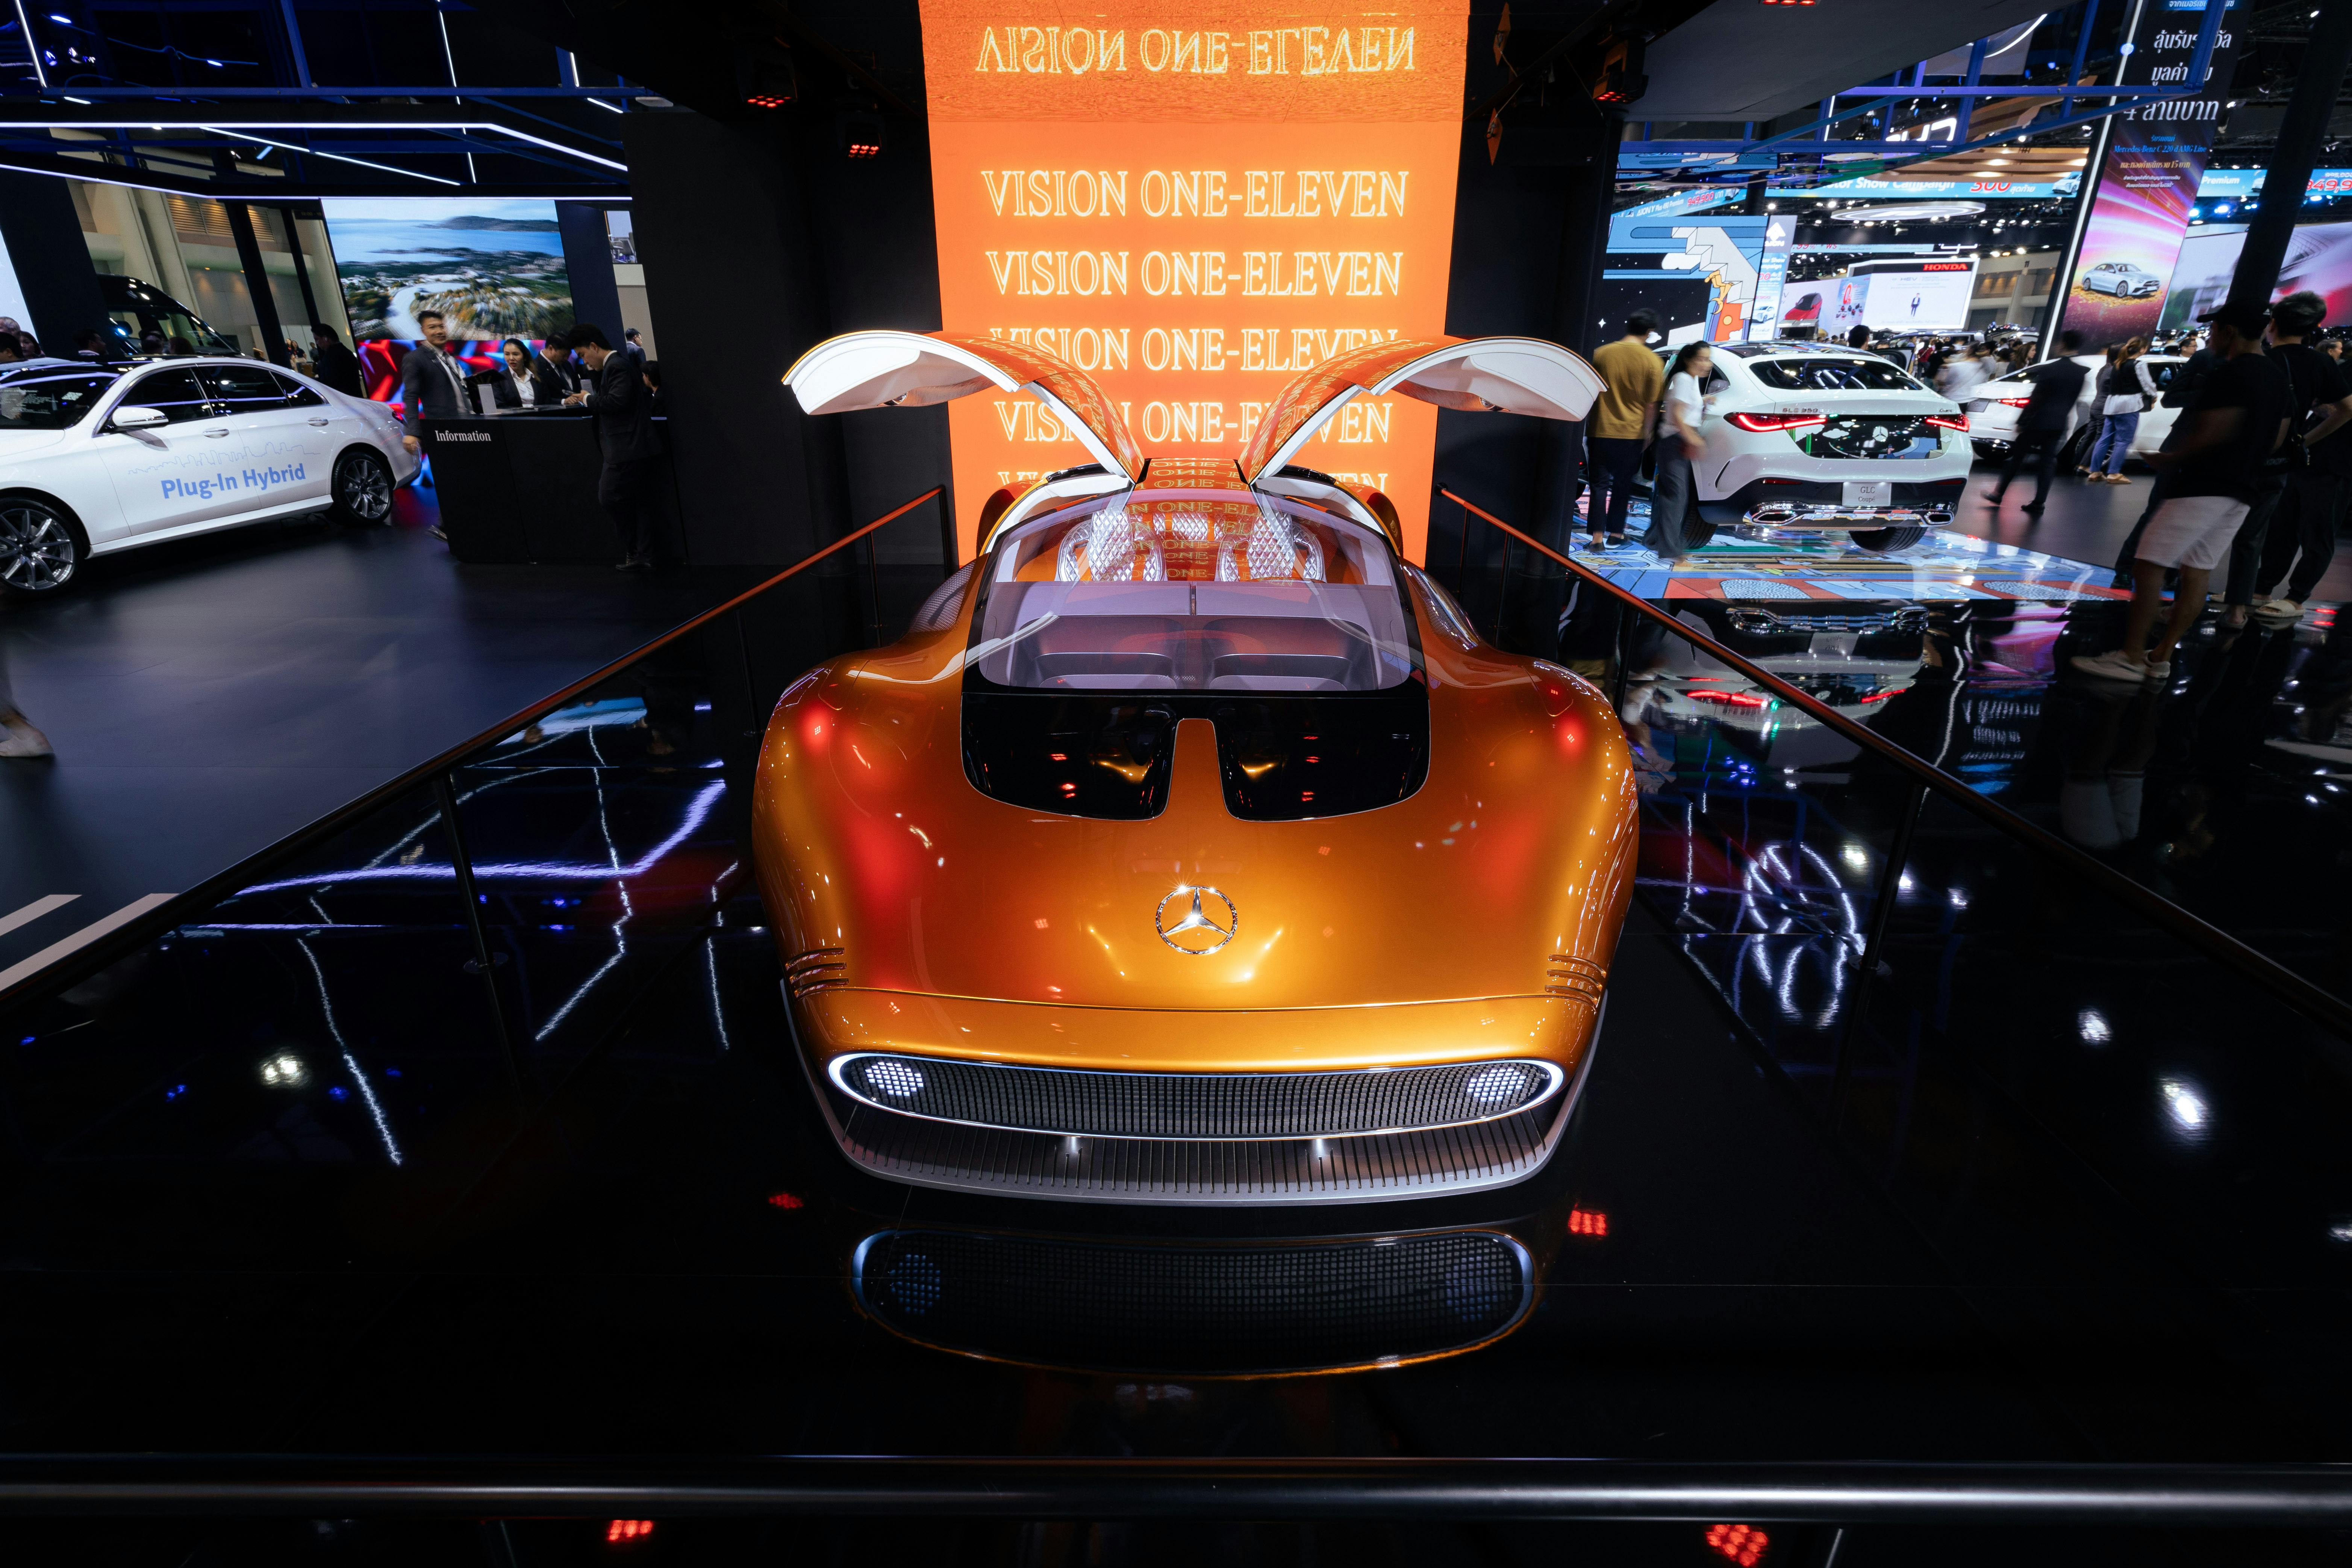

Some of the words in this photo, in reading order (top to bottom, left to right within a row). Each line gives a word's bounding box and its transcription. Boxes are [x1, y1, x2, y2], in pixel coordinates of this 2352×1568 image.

[2142, 101, 2219, 121] ลานบาท
[2114, 144, 2156, 153] Mercedes-Benz
[1823, 179, 1853, 188] otor
[1855, 177, 1892, 188] Show
[1893, 181, 1955, 191] Campaign
[2202, 176, 2240, 184] Premium
[981, 170, 1128, 217] VISION
[1141, 170, 1409, 217] ONE-ELEVEN
[986, 251, 1129, 295] VISION
[1141, 251, 1403, 295] ONE-ELEVEN
[435, 430, 492, 441] Information
[161, 473, 238, 500] Plug-In
[242, 463, 306, 491] Hybrid
